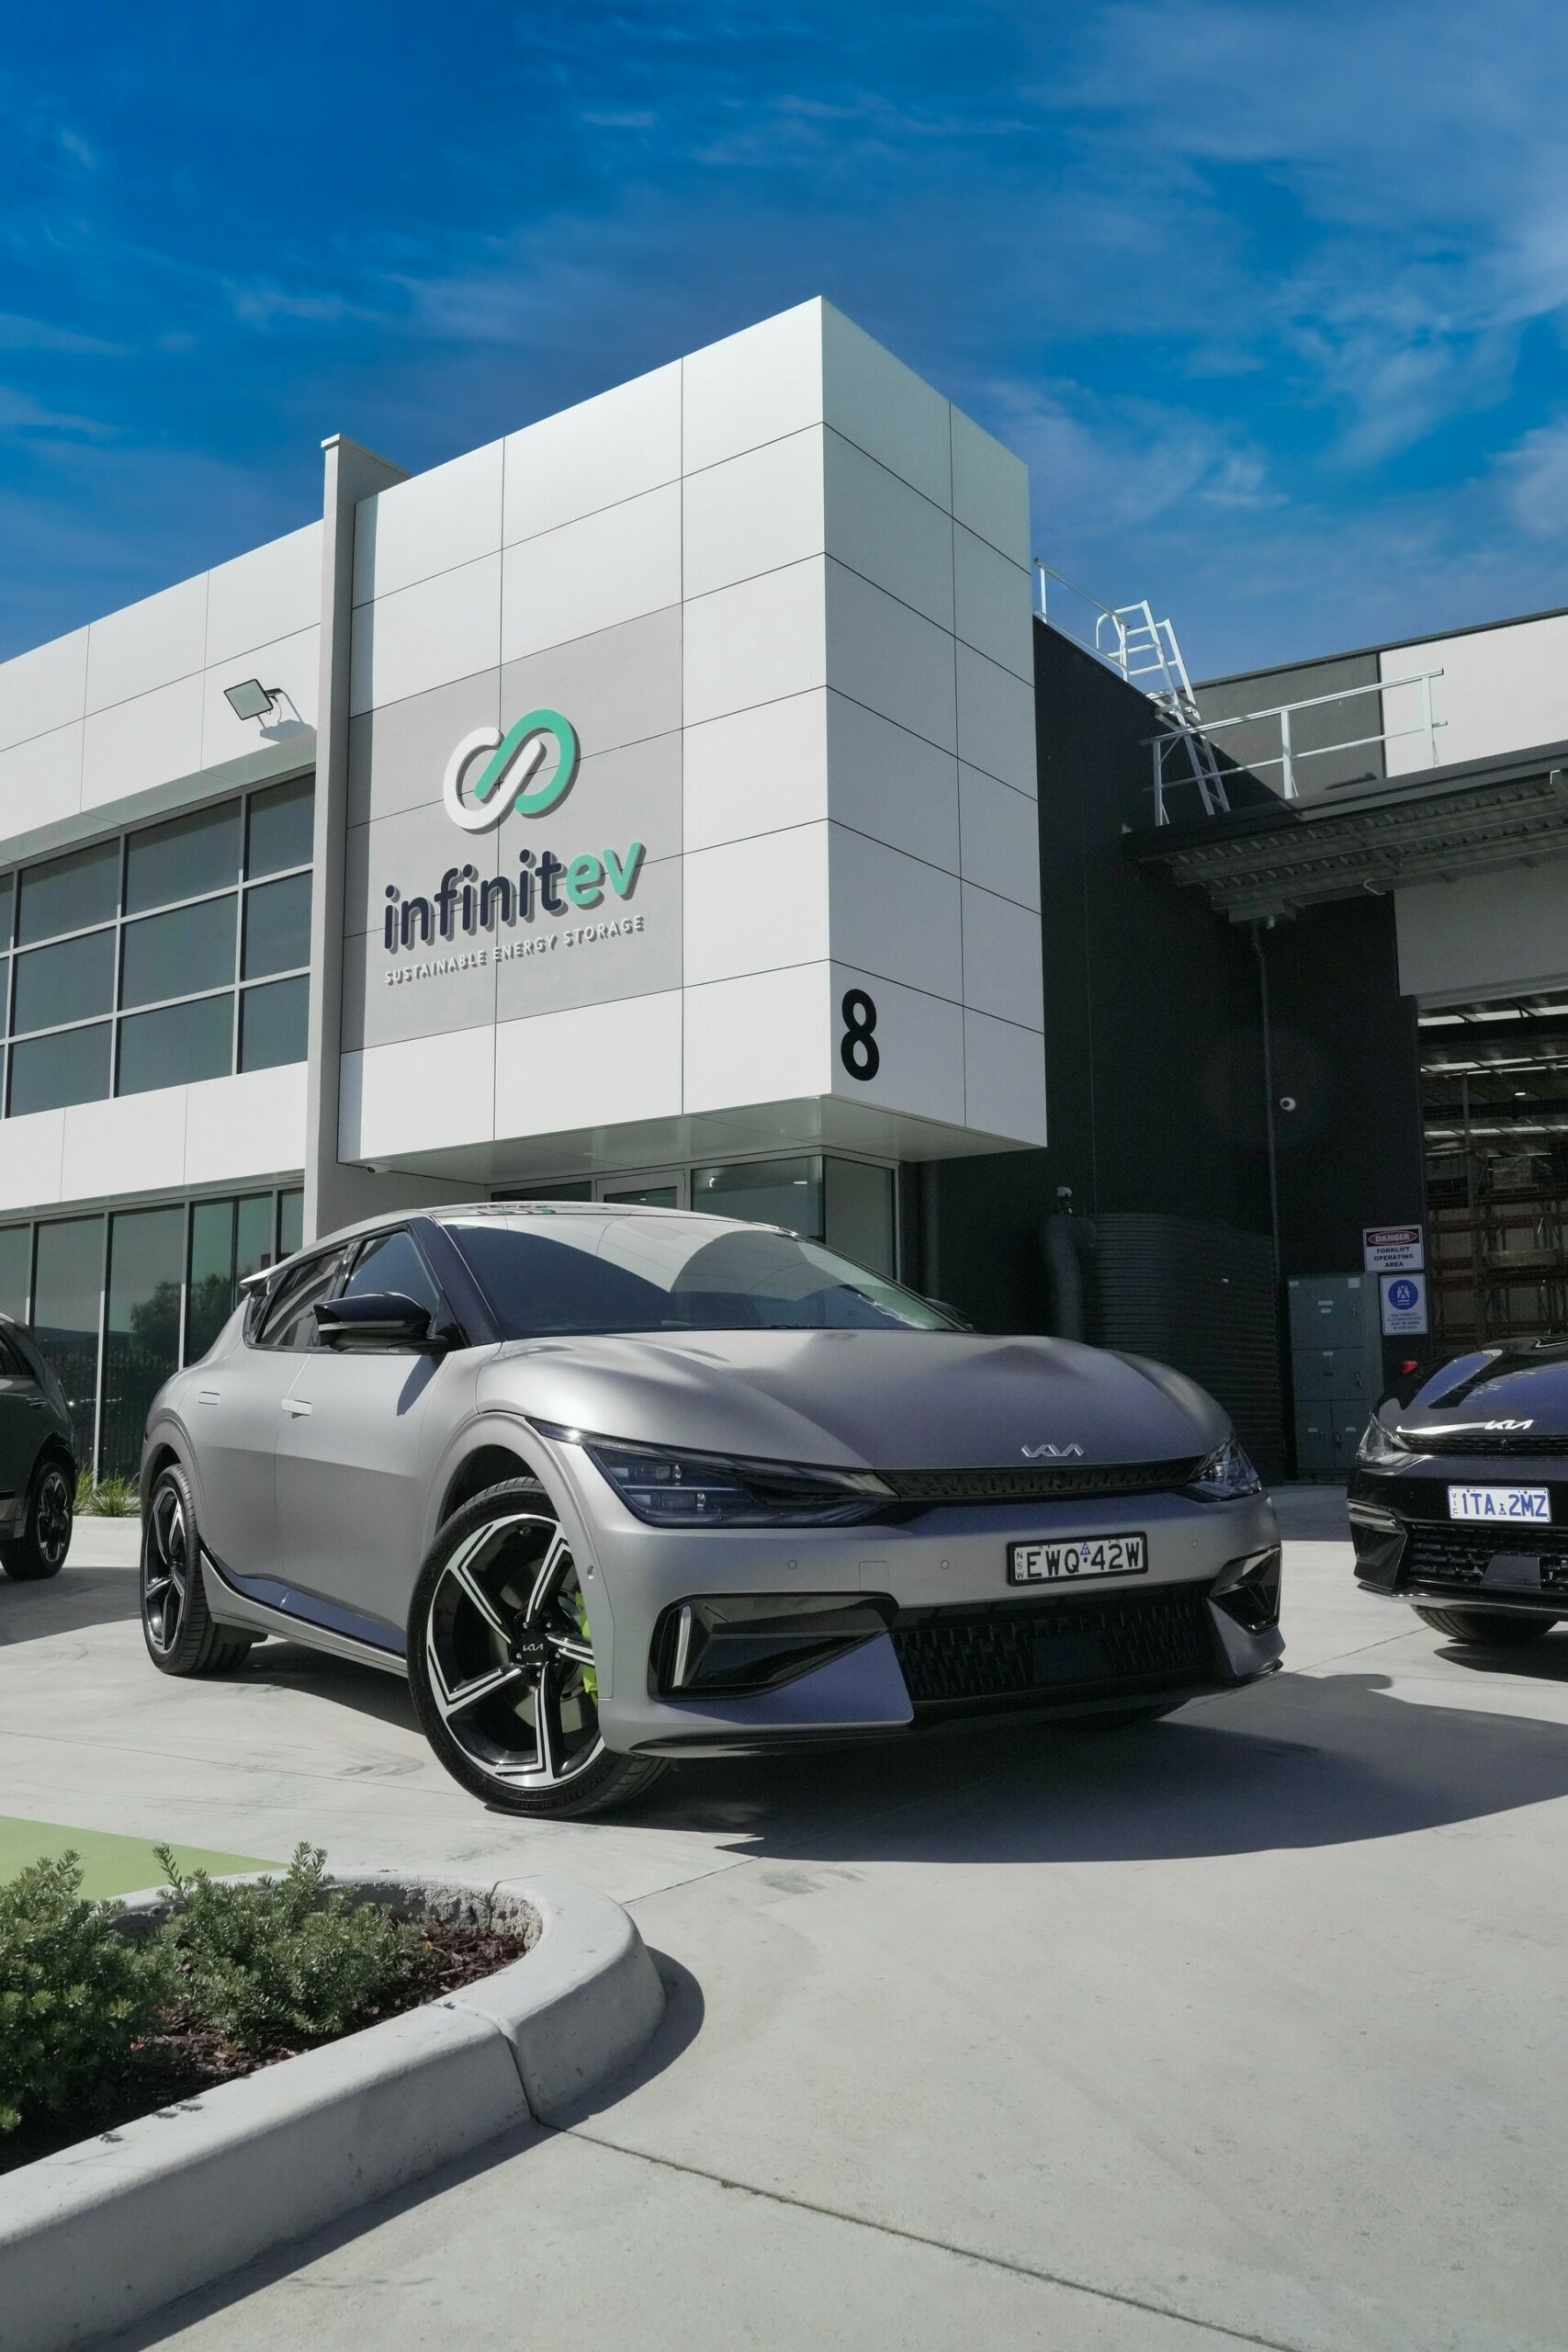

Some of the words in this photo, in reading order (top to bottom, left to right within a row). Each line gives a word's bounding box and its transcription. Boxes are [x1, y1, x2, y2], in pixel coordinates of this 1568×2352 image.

[384, 842, 643, 950] infinitev
[384, 950, 487, 985] SUSTAINABLE
[492, 934, 557, 961] ENERGY
[562, 915, 645, 945] STORAGE
[840, 989, 879, 1081] 8
[1375, 1233, 1410, 1242] DANGER
[1374, 1253, 1414, 1261] OPERATING
[1507, 1494, 1548, 1518] 2MZ
[1016, 1551, 1025, 1579] NSW
[1090, 1542, 1140, 1570] 42W
